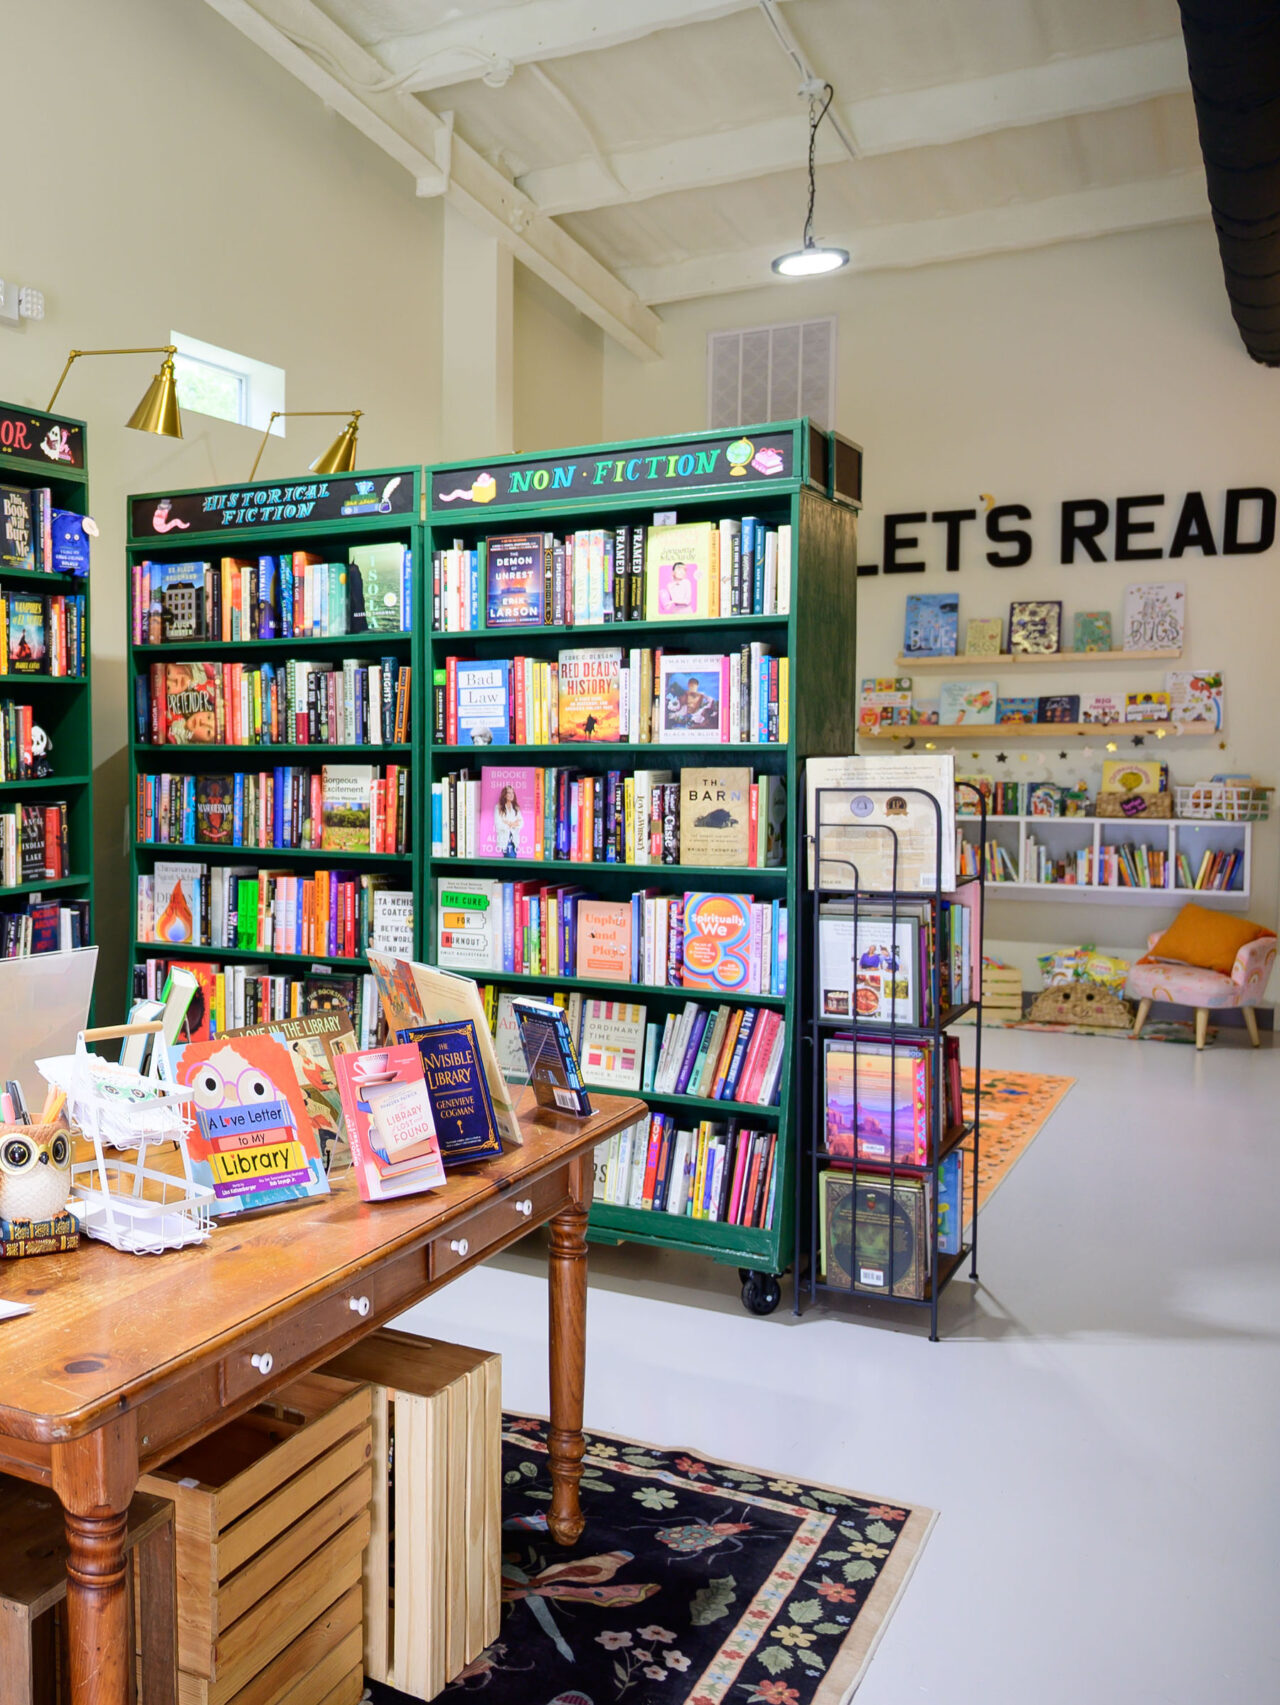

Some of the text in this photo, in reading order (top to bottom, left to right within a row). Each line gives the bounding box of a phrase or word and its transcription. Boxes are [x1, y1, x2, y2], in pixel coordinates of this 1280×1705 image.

[202, 482, 330, 513] HISTORICAL
[3, 499, 29, 519] Book
[222, 502, 316, 525] FICTION
[12, 515, 25, 529] Will
[857, 487, 1277, 575] ET'S READ
[6, 523, 29, 542] Bury
[15, 542, 30, 557] Me
[616, 529, 625, 575] FRAMED
[632, 528, 642, 574] FRAMED
[497, 557, 532, 566] DEMON
[496, 570, 533, 580] UNREST
[490, 607, 538, 618] LARSON
[466, 673, 495, 686] Bad
[561, 663, 581, 678] RED
[567, 678, 612, 696] HISTORY
[26, 853, 42, 861] LAKE
[699, 921, 727, 937] We
[284, 1015, 341, 1038] THE LIBRARY
[589, 1023, 639, 1034] ORDINARY
[589, 1033, 610, 1041] TIME
[421, 1050, 474, 1073] INVISIBLE
[428, 1068, 471, 1090] LIBRARY
[436, 1096, 475, 1110] GENEVIEVE
[209, 1118, 218, 1130] A
[248, 1109, 282, 1123] Letter
[386, 1104, 423, 1126] LIBRARY
[440, 1106, 475, 1119] COGMAN
[239, 1134, 265, 1145] to My
[394, 1123, 429, 1144] FOUND
[221, 1148, 288, 1176] Library
